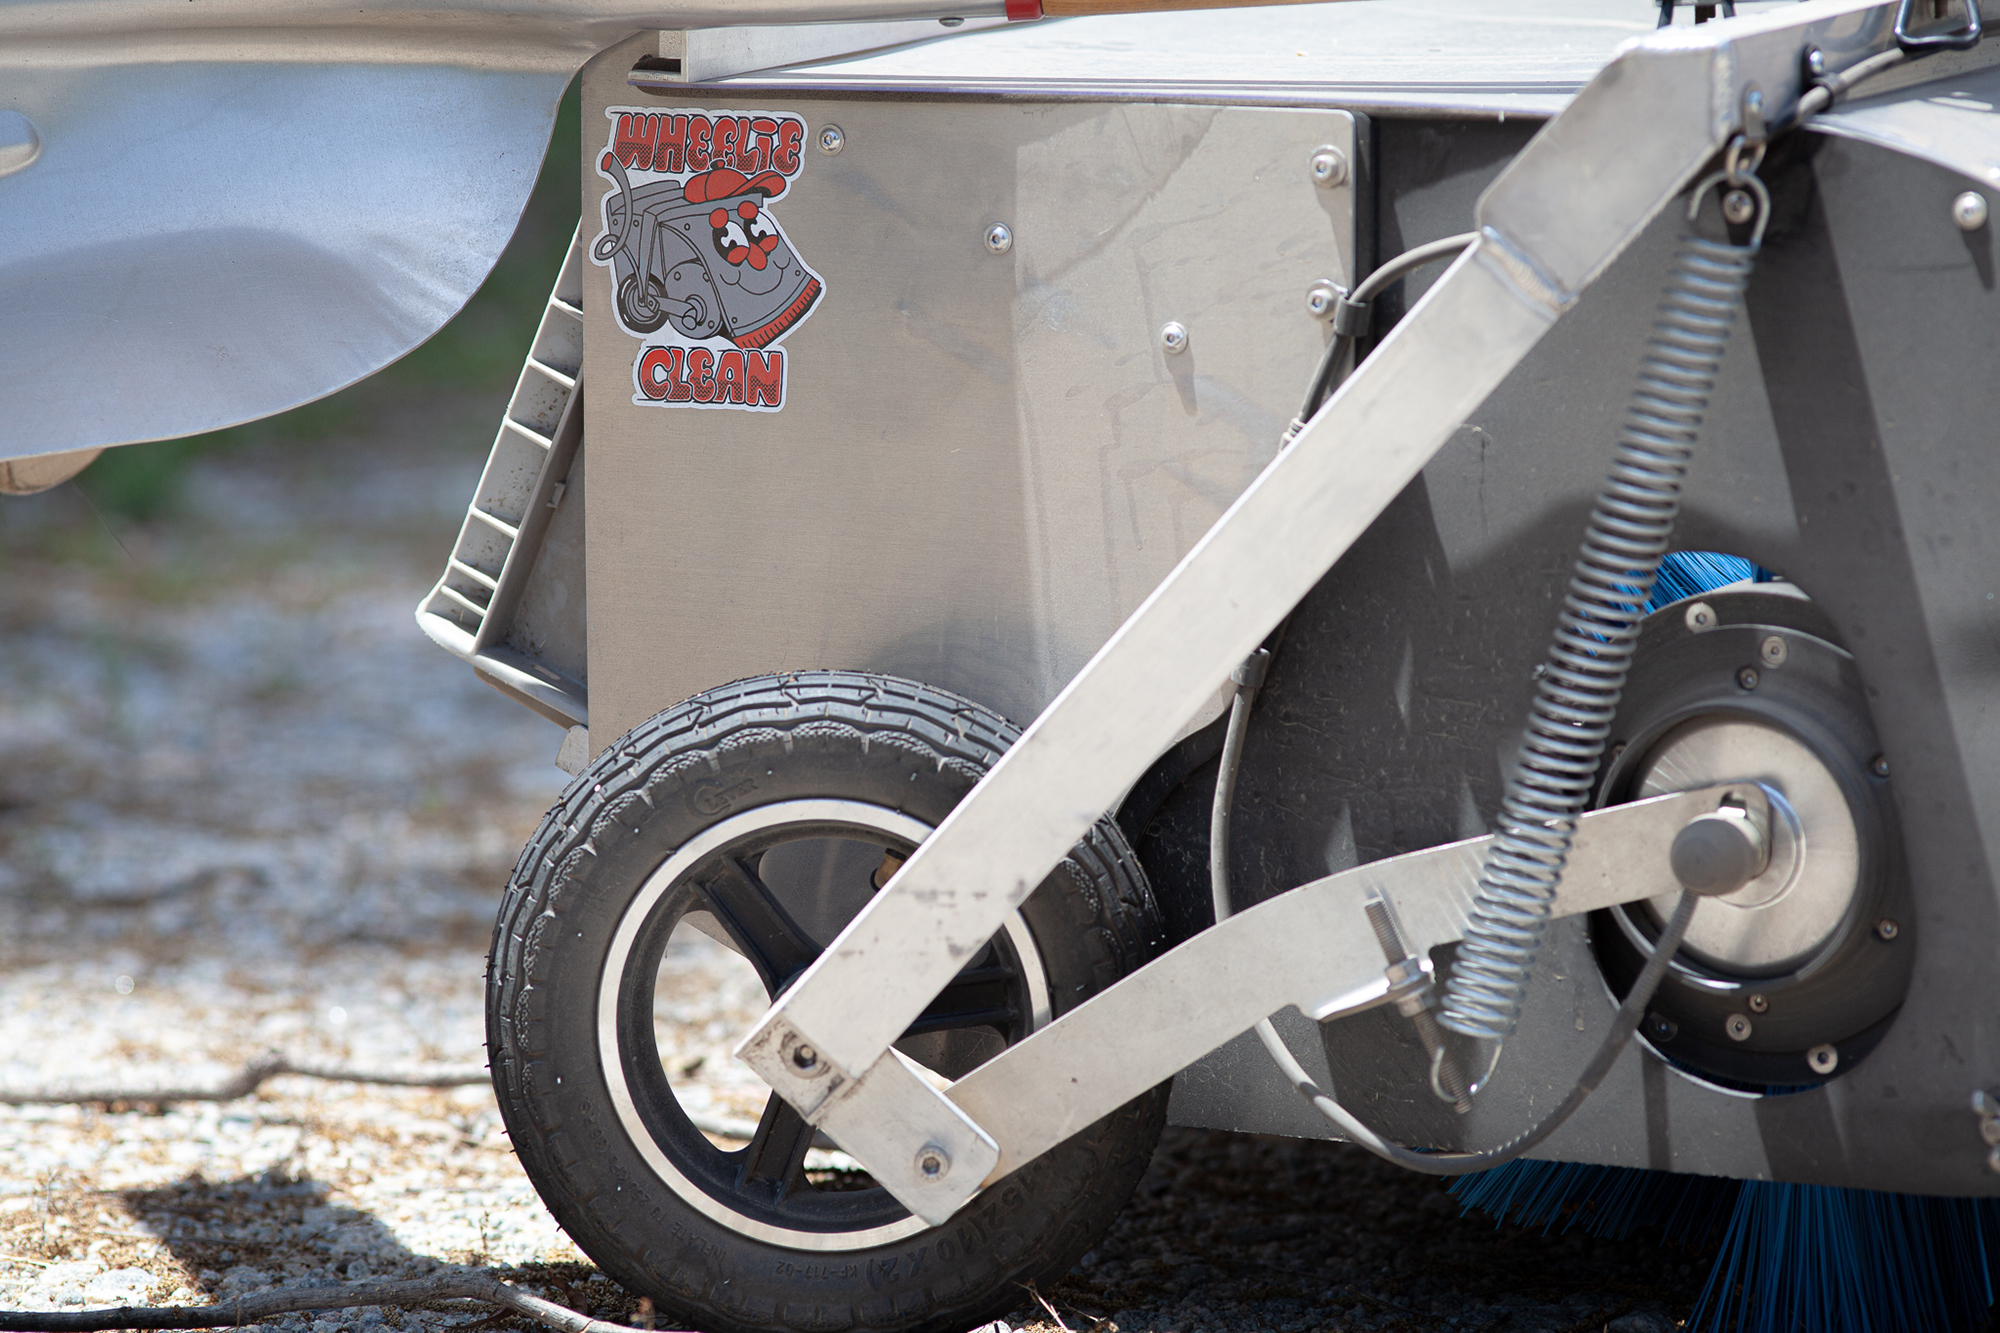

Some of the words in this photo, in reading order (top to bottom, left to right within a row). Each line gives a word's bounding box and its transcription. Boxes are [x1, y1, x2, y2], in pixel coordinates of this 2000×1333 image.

[613, 113, 804, 176] WHEELIE
[638, 347, 783, 407] CLEAN
[670, 1222, 728, 1262] INFLATE
[774, 1260, 858, 1279] KF-717-02
